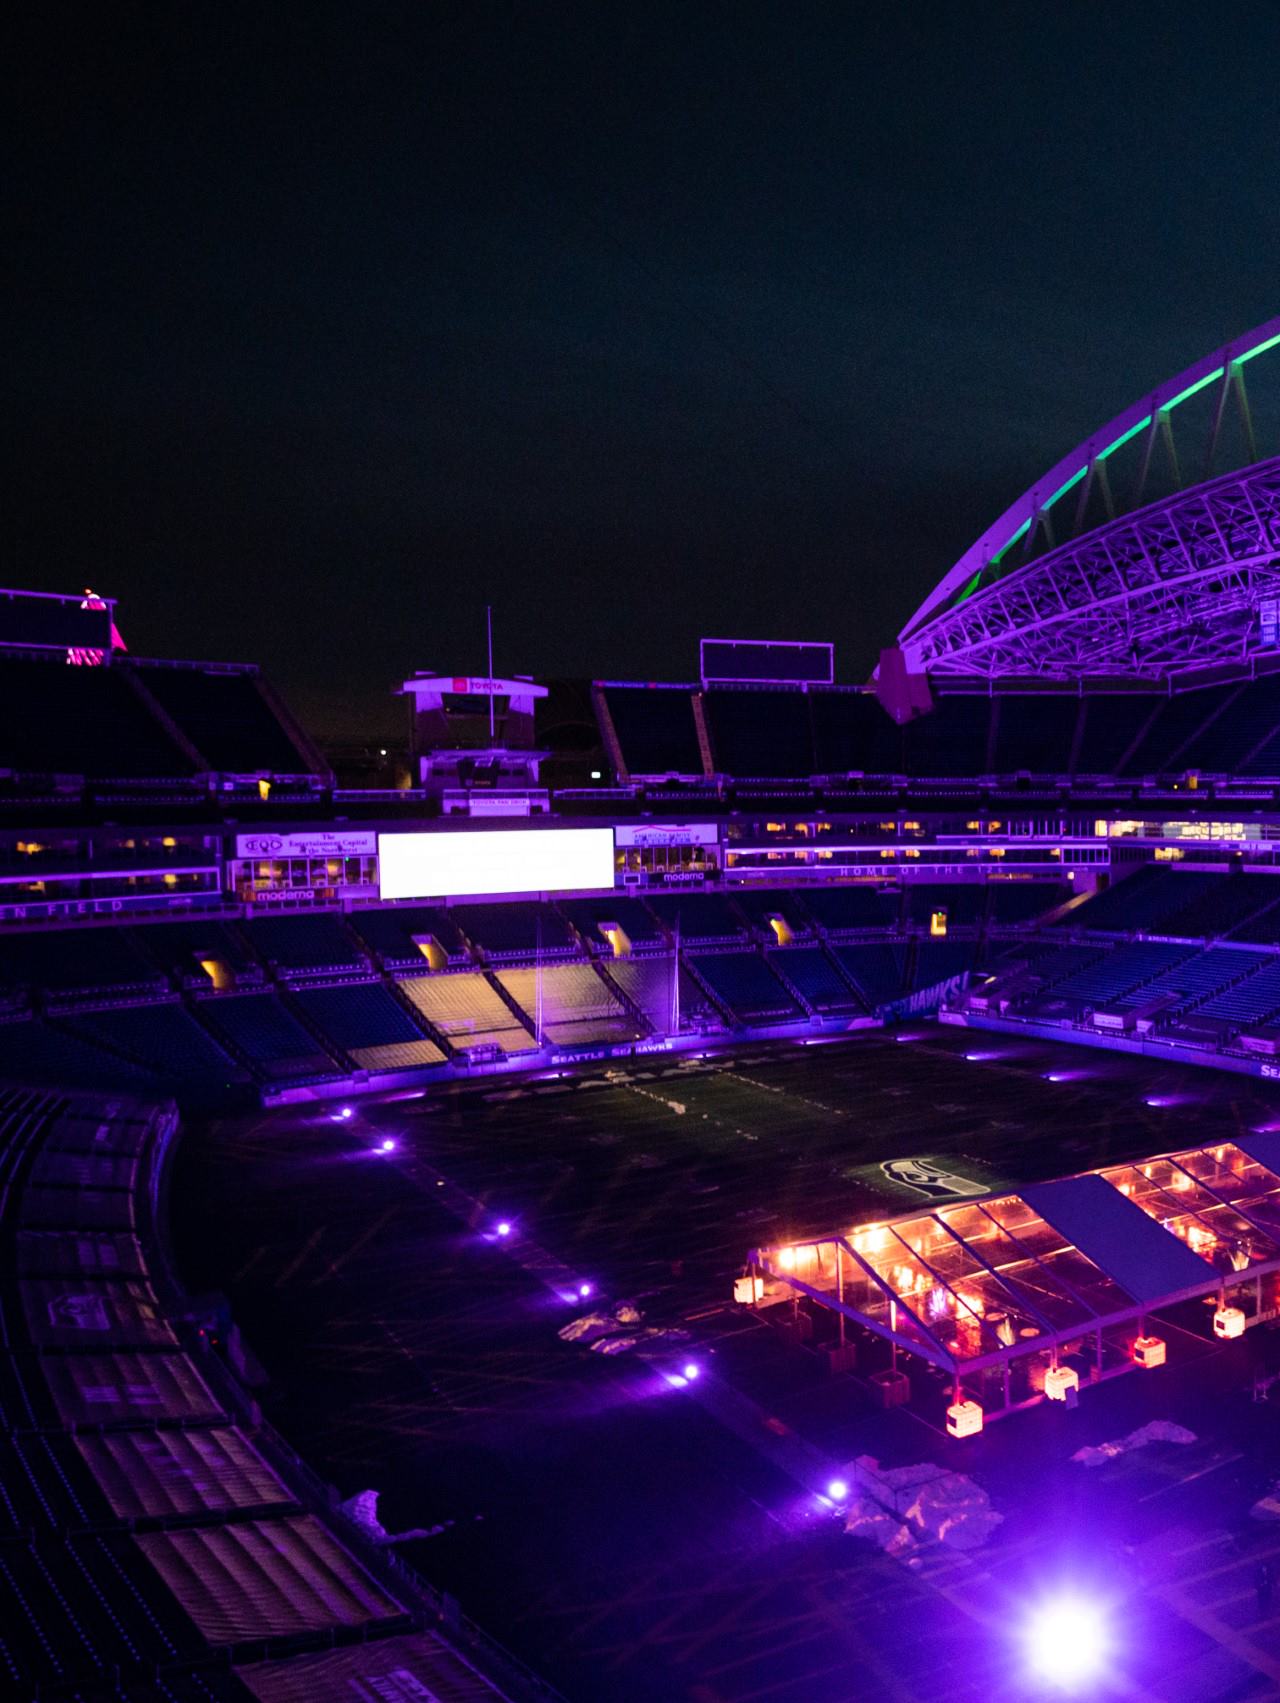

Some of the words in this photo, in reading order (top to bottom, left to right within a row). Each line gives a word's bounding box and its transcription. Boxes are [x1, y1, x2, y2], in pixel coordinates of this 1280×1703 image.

[471, 682, 503, 690] TOYOTA
[342, 839, 368, 848] Capital
[840, 866, 888, 876] HOME
[901, 866, 921, 875] OF
[934, 866, 963, 874] THE
[663, 872, 705, 882] moderna
[257, 889, 315, 901] moderna
[48, 901, 122, 915] FIELD
[551, 1051, 605, 1065] SEATTLE
